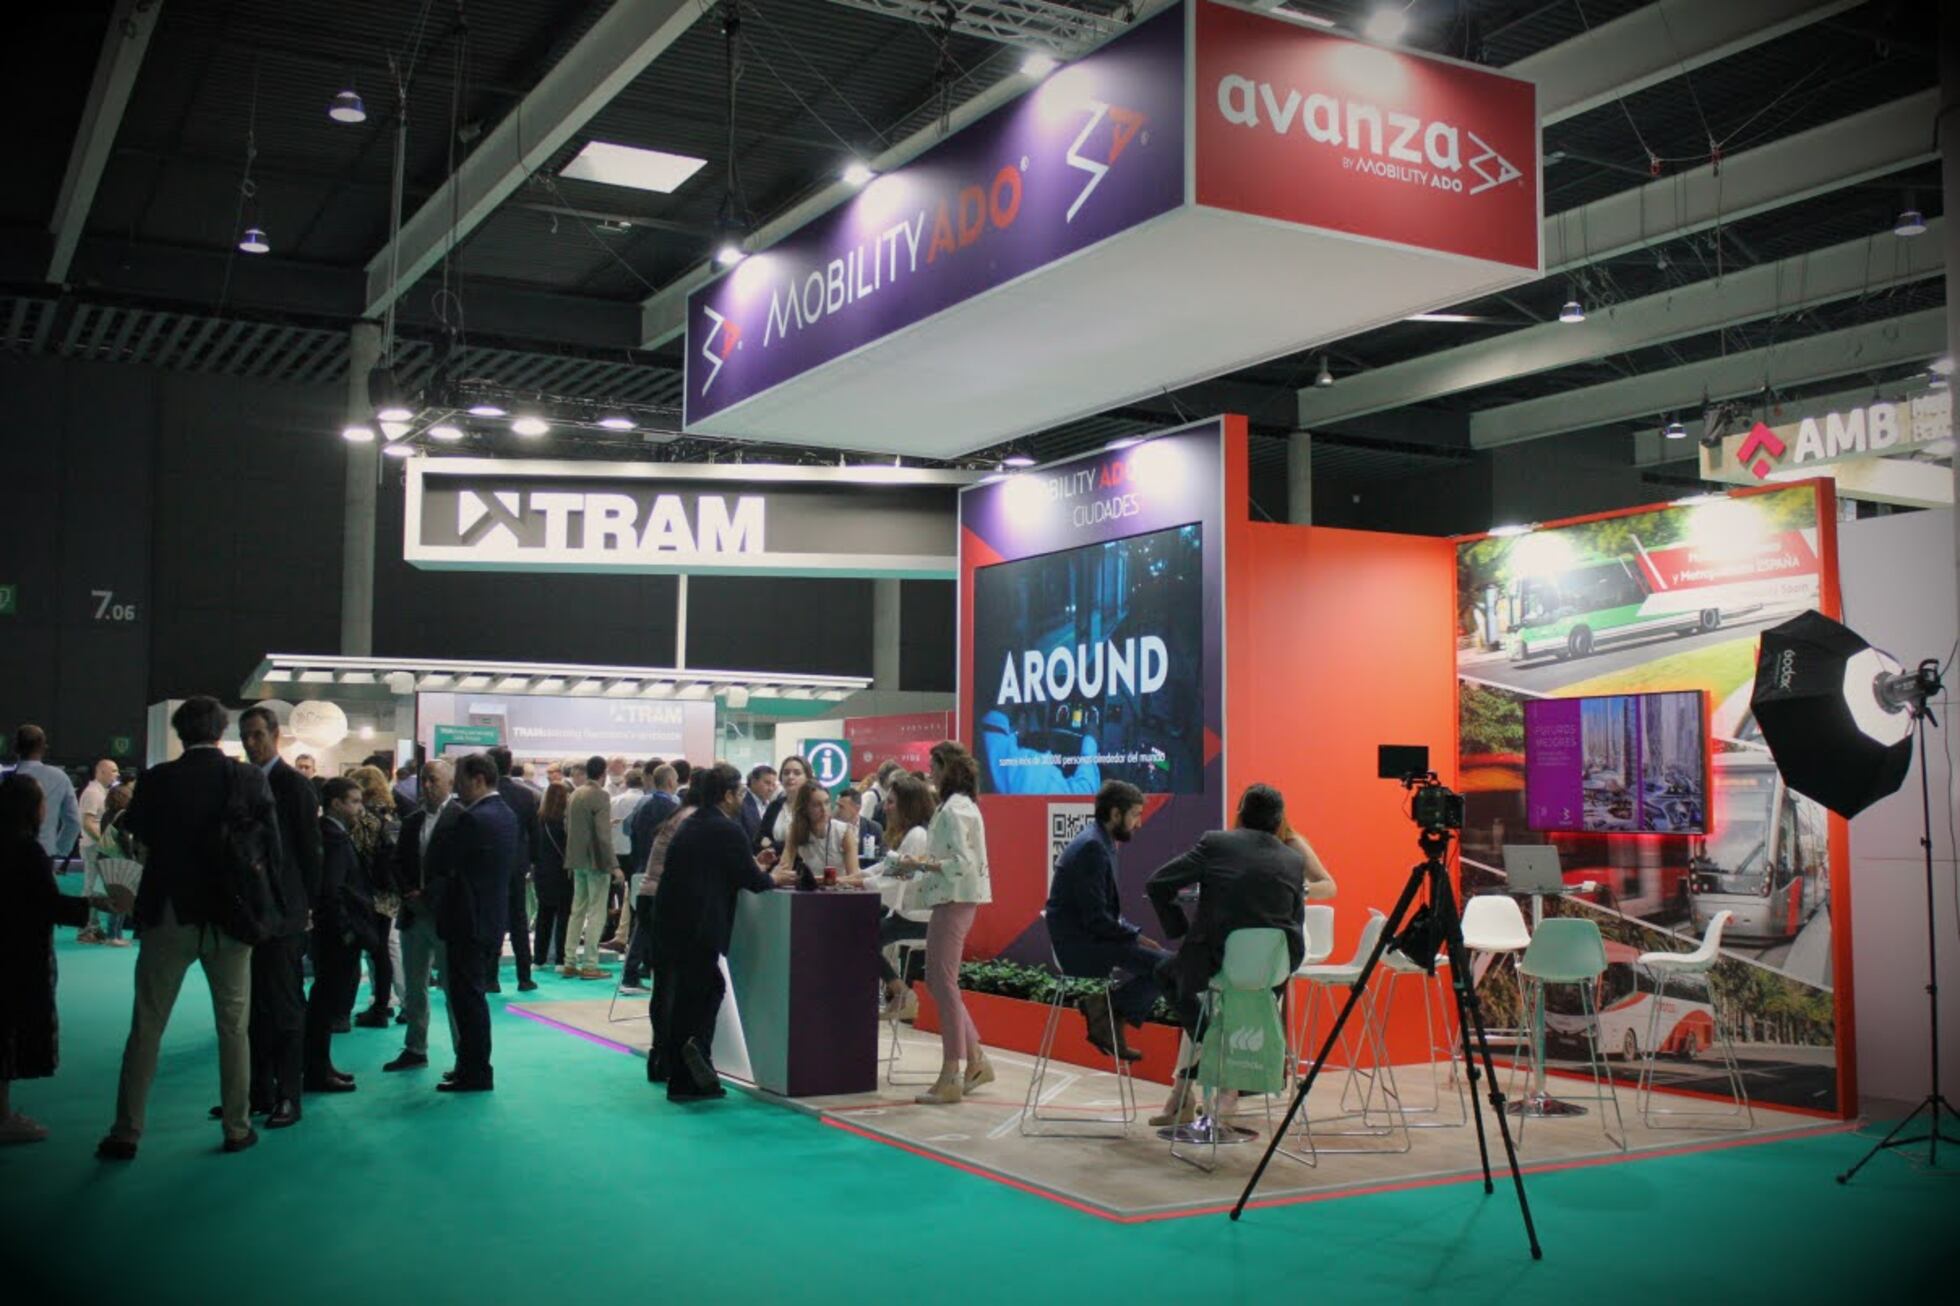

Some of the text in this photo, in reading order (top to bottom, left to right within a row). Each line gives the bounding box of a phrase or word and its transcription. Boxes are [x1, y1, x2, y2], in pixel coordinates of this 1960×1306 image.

[1218, 73, 1462, 173] avanza
[1343, 155, 1463, 192] BY MOBILITY ADO
[1793, 403, 1899, 464] AMB
[1072, 492, 1142, 528] CIUDADES
[91, 589, 136, 621] 7.06
[996, 634, 1168, 706] AROUND
[1127, 751, 1138, 763] del
